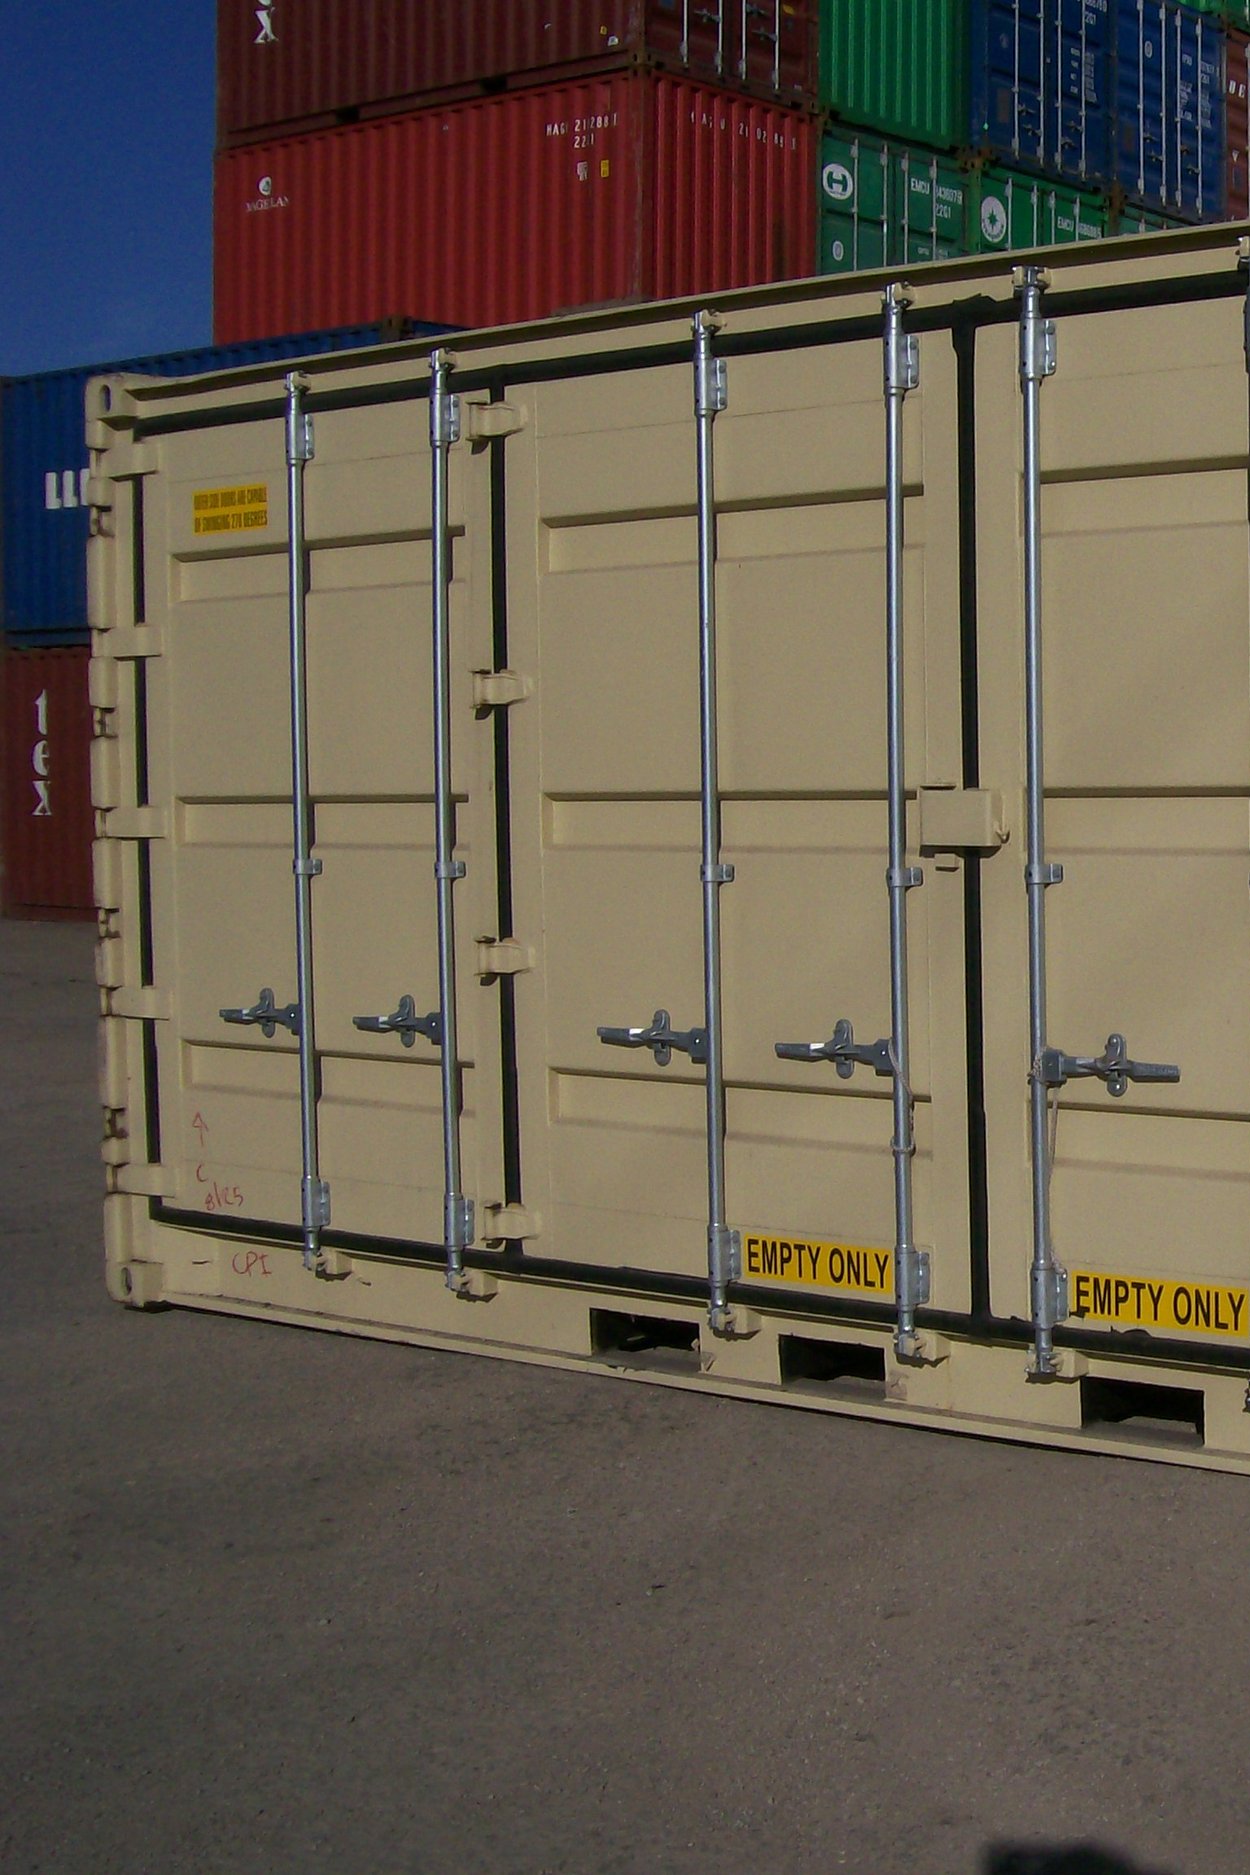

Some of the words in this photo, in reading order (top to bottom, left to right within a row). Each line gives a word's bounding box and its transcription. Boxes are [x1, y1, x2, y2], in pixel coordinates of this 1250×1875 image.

[220, 490, 237, 507] DOORS
[243, 509, 268, 528] DEGREES
[747, 1238, 821, 1280] EMPTY
[829, 1247, 889, 1289] ONLY
[1076, 1275, 1164, 1321] EMPTY
[1173, 1286, 1246, 1331] ONLY
